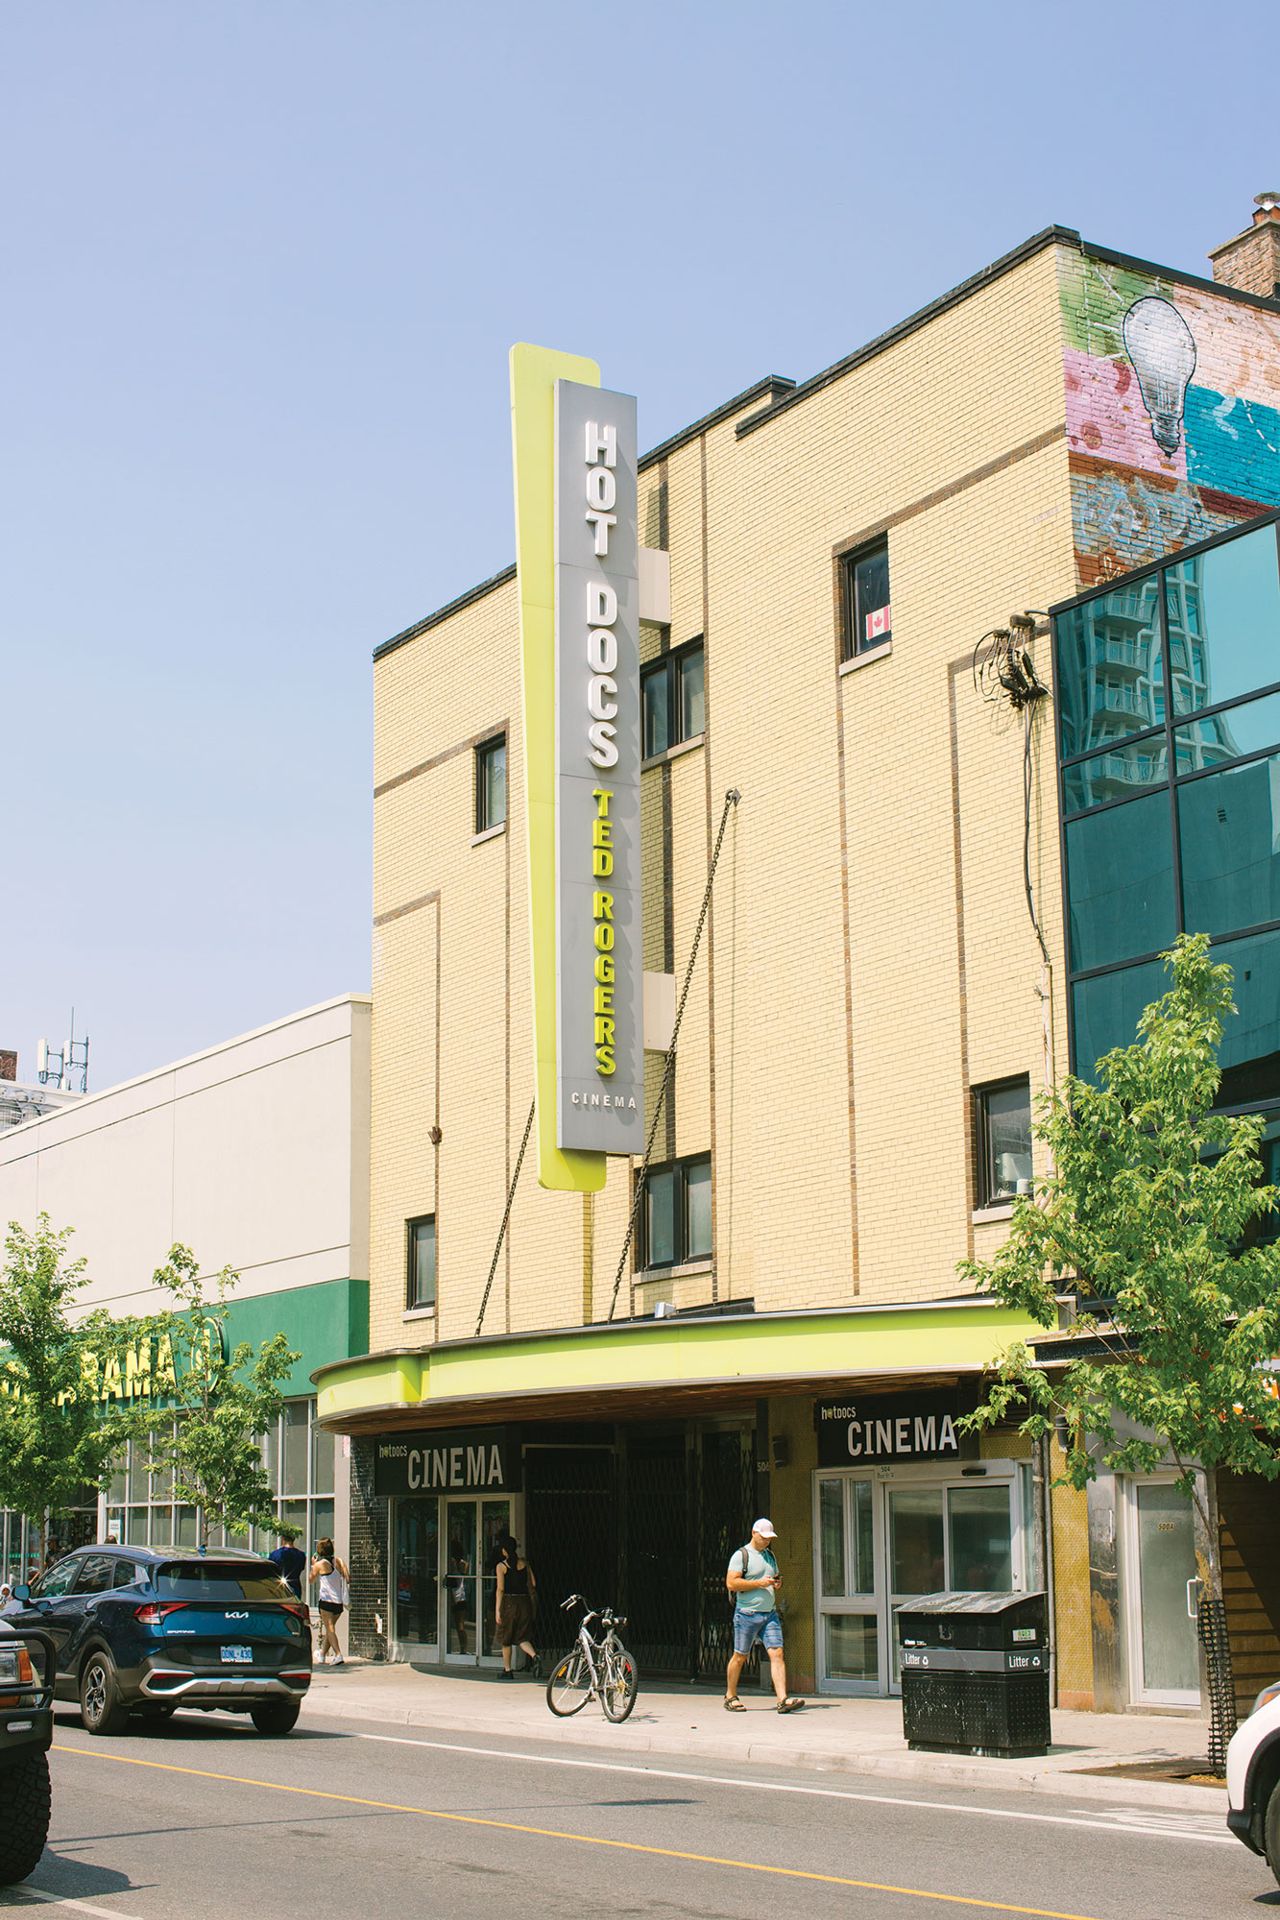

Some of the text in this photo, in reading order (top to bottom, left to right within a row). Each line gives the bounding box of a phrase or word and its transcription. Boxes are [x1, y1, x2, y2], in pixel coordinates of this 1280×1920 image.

[585, 420, 619, 769] HOT DOCS
[592, 788, 616, 1077] TED ROGERS
[572, 1092, 636, 1109] CINEMA
[847, 1414, 958, 1457] CINEMA
[408, 1444, 504, 1489] CINEMA
[224, 1611, 249, 1619] KIA
[905, 1653, 920, 1665] Litter
[1009, 1656, 1030, 1668] Litter
